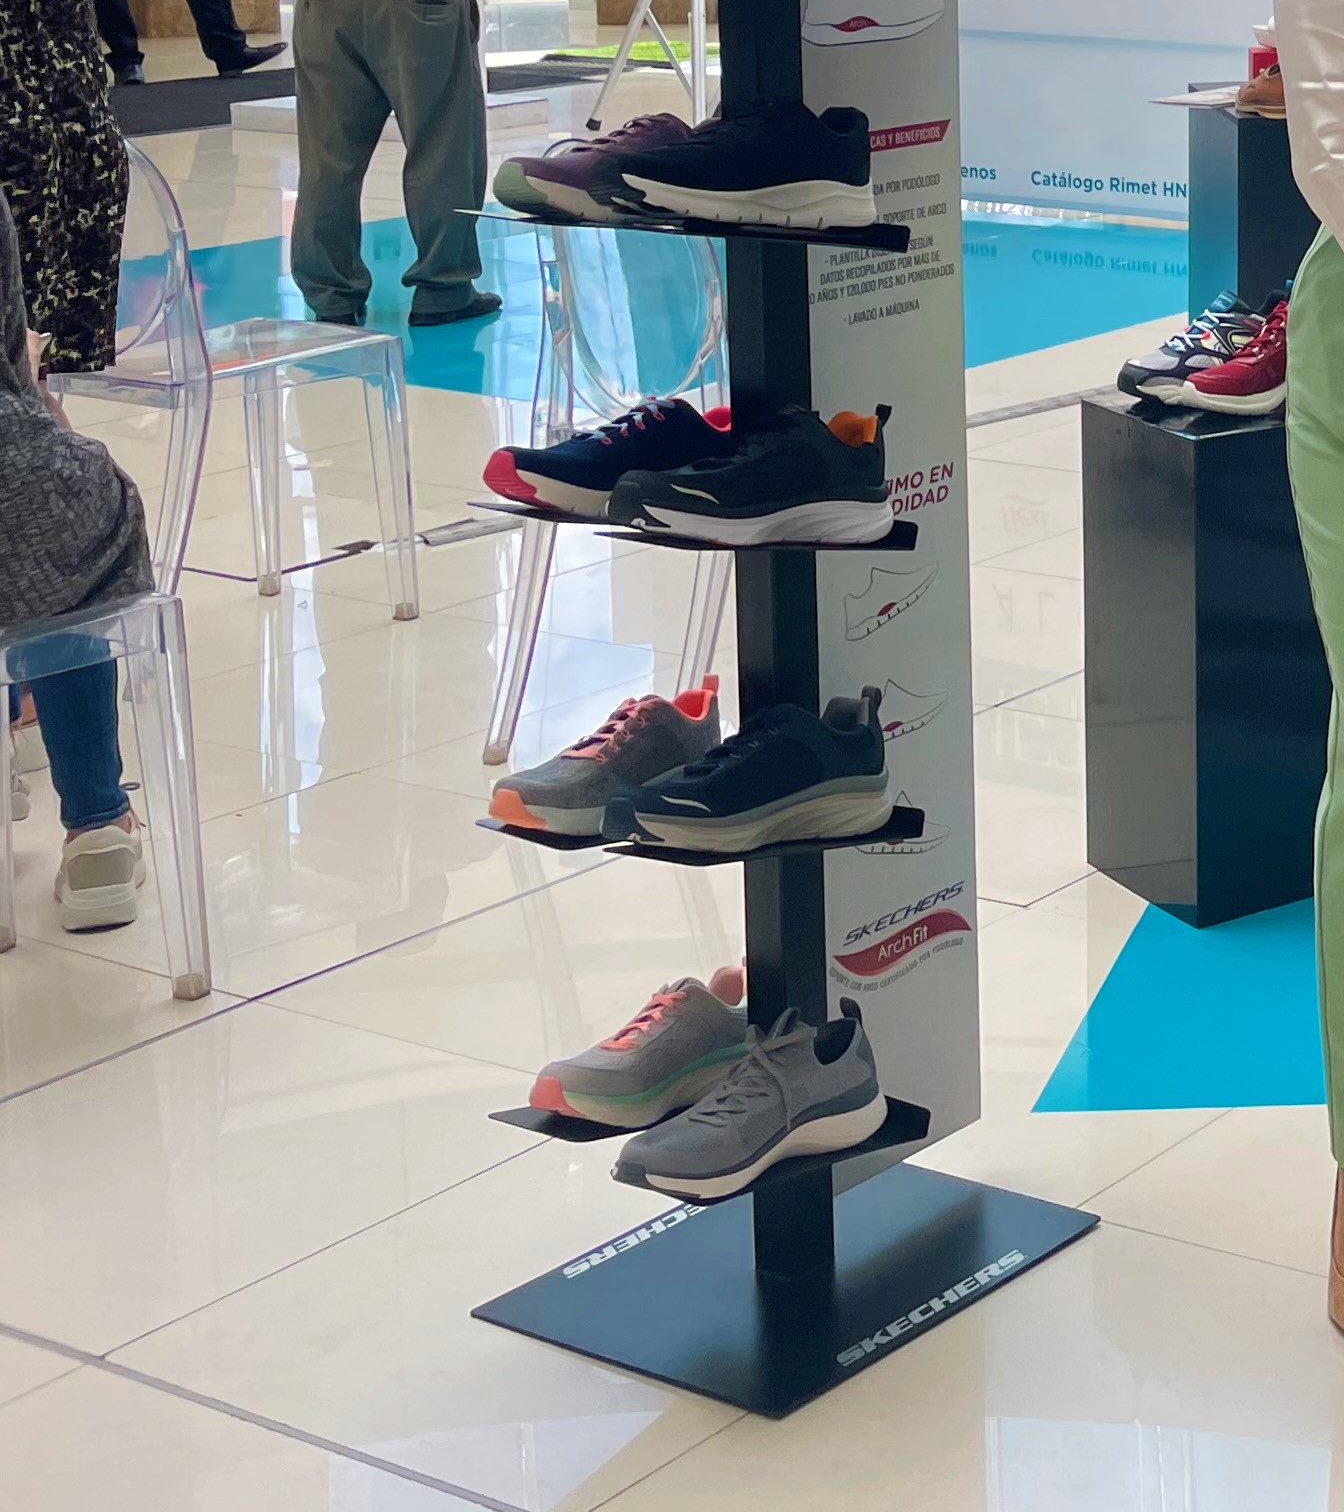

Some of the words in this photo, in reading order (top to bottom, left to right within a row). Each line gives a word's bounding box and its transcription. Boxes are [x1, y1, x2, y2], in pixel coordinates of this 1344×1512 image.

[887, 133, 894, 145] Y
[895, 126, 941, 144] BENEFICIOS
[885, 180, 901, 194] POR
[1031, 170, 1104, 193] Catálogo
[1110, 177, 1157, 196] Rimet
[1163, 182, 1188, 198] HN
[917, 206, 927, 219] DE
[927, 202, 947, 217] ARCO
[820, 270, 845, 286] DATOS
[845, 259, 896, 280] RECOPILADOS
[897, 256, 912, 268] POR
[913, 251, 930, 265] MÁS
[931, 250, 941, 262] DE
[817, 287, 838, 303] AÑOS
[839, 286, 846, 298] Y
[877, 276, 894, 291] PIES
[895, 274, 907, 287] NO
[907, 263, 955, 284] PONDERADOS
[848, 307, 877, 326] LAVADO
[879, 306, 885, 318] A
[885, 298, 921, 317] MÁQUINA
[930, 461, 954, 484] EN
[843, 880, 965, 947] SKECHERS
[836, 1249, 1025, 1368] SKECHERS
